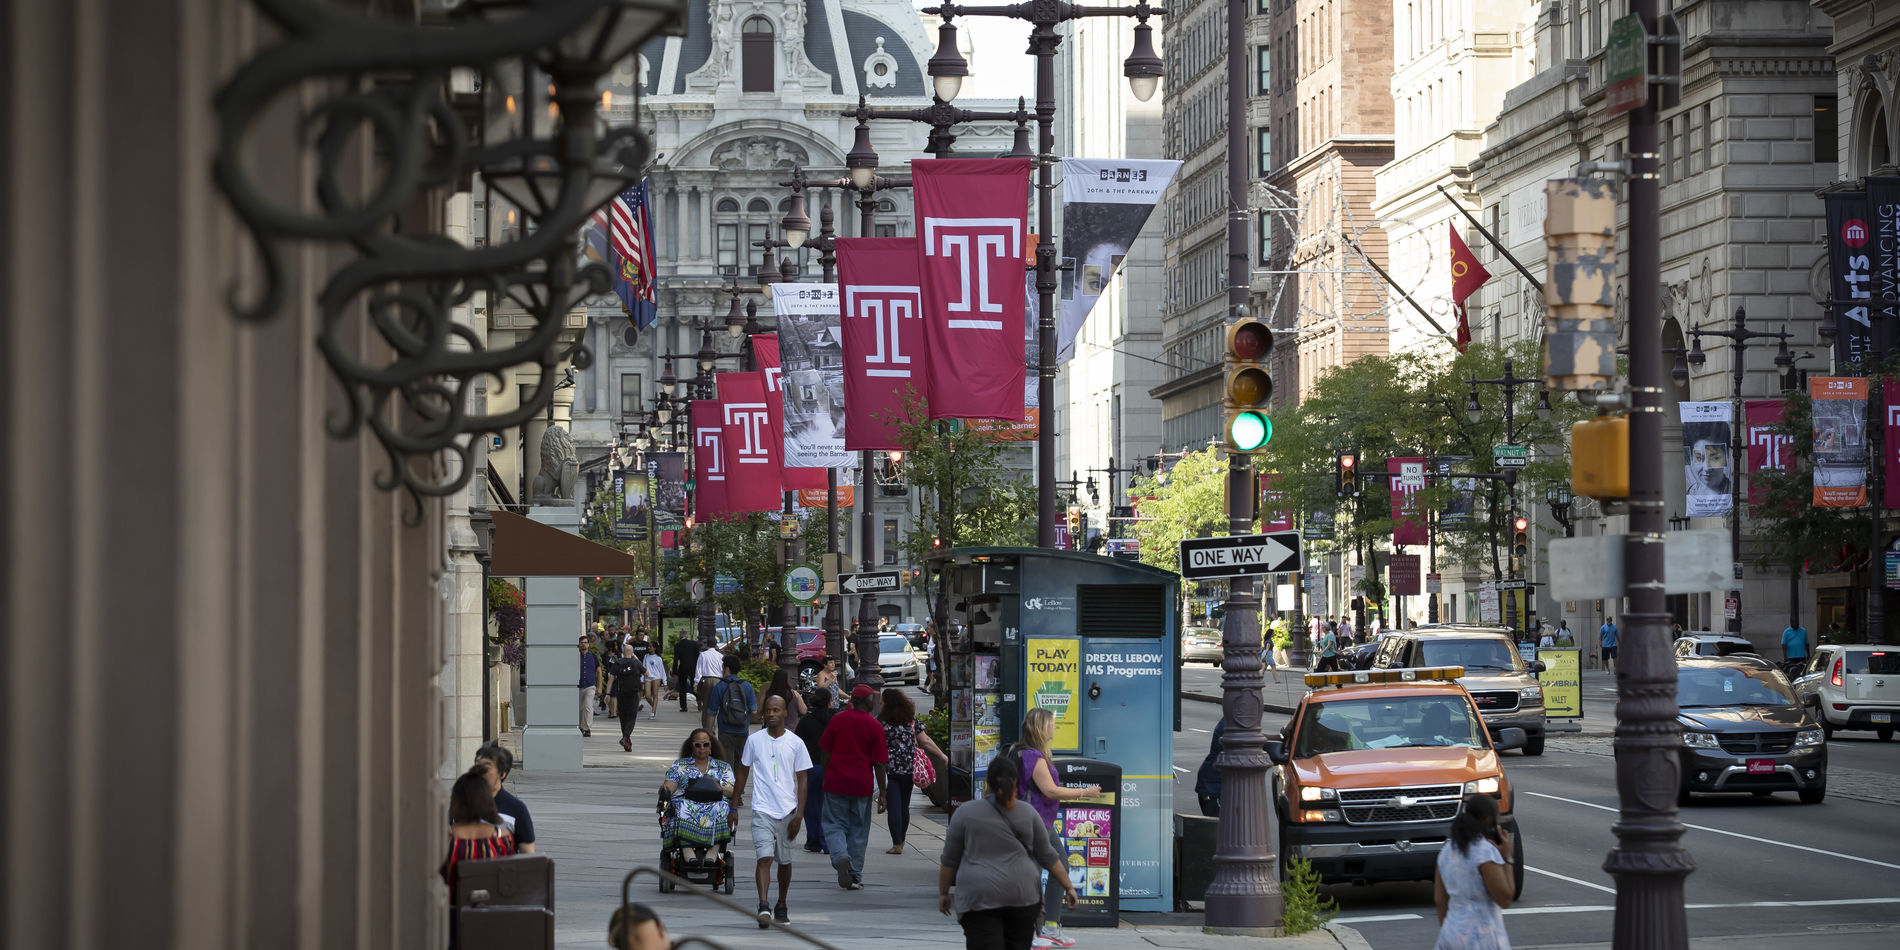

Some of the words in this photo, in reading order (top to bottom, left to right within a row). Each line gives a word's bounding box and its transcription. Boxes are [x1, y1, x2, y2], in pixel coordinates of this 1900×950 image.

[1100, 169, 1147, 182] BARNES
[1879, 204, 1897, 317] ADVANCING
[1844, 254, 1871, 328] Arts
[1194, 549, 1226, 566] ONE
[1232, 546, 1264, 563] WAY
[856, 578, 875, 588] ONE
[876, 577, 894, 586] WAY
[1036, 649, 1070, 659] PLAY
[1086, 654, 1123, 662] DREXEL
[1126, 654, 1163, 662] LEBOW
[1030, 663, 1077, 673] TODAY!
[1086, 665, 1104, 675] MS
[1107, 665, 1162, 678] Programs
[1551, 696, 1567, 704] VALET
[1066, 810, 1088, 820] MEAN
[1089, 810, 1110, 822] GIRLS
